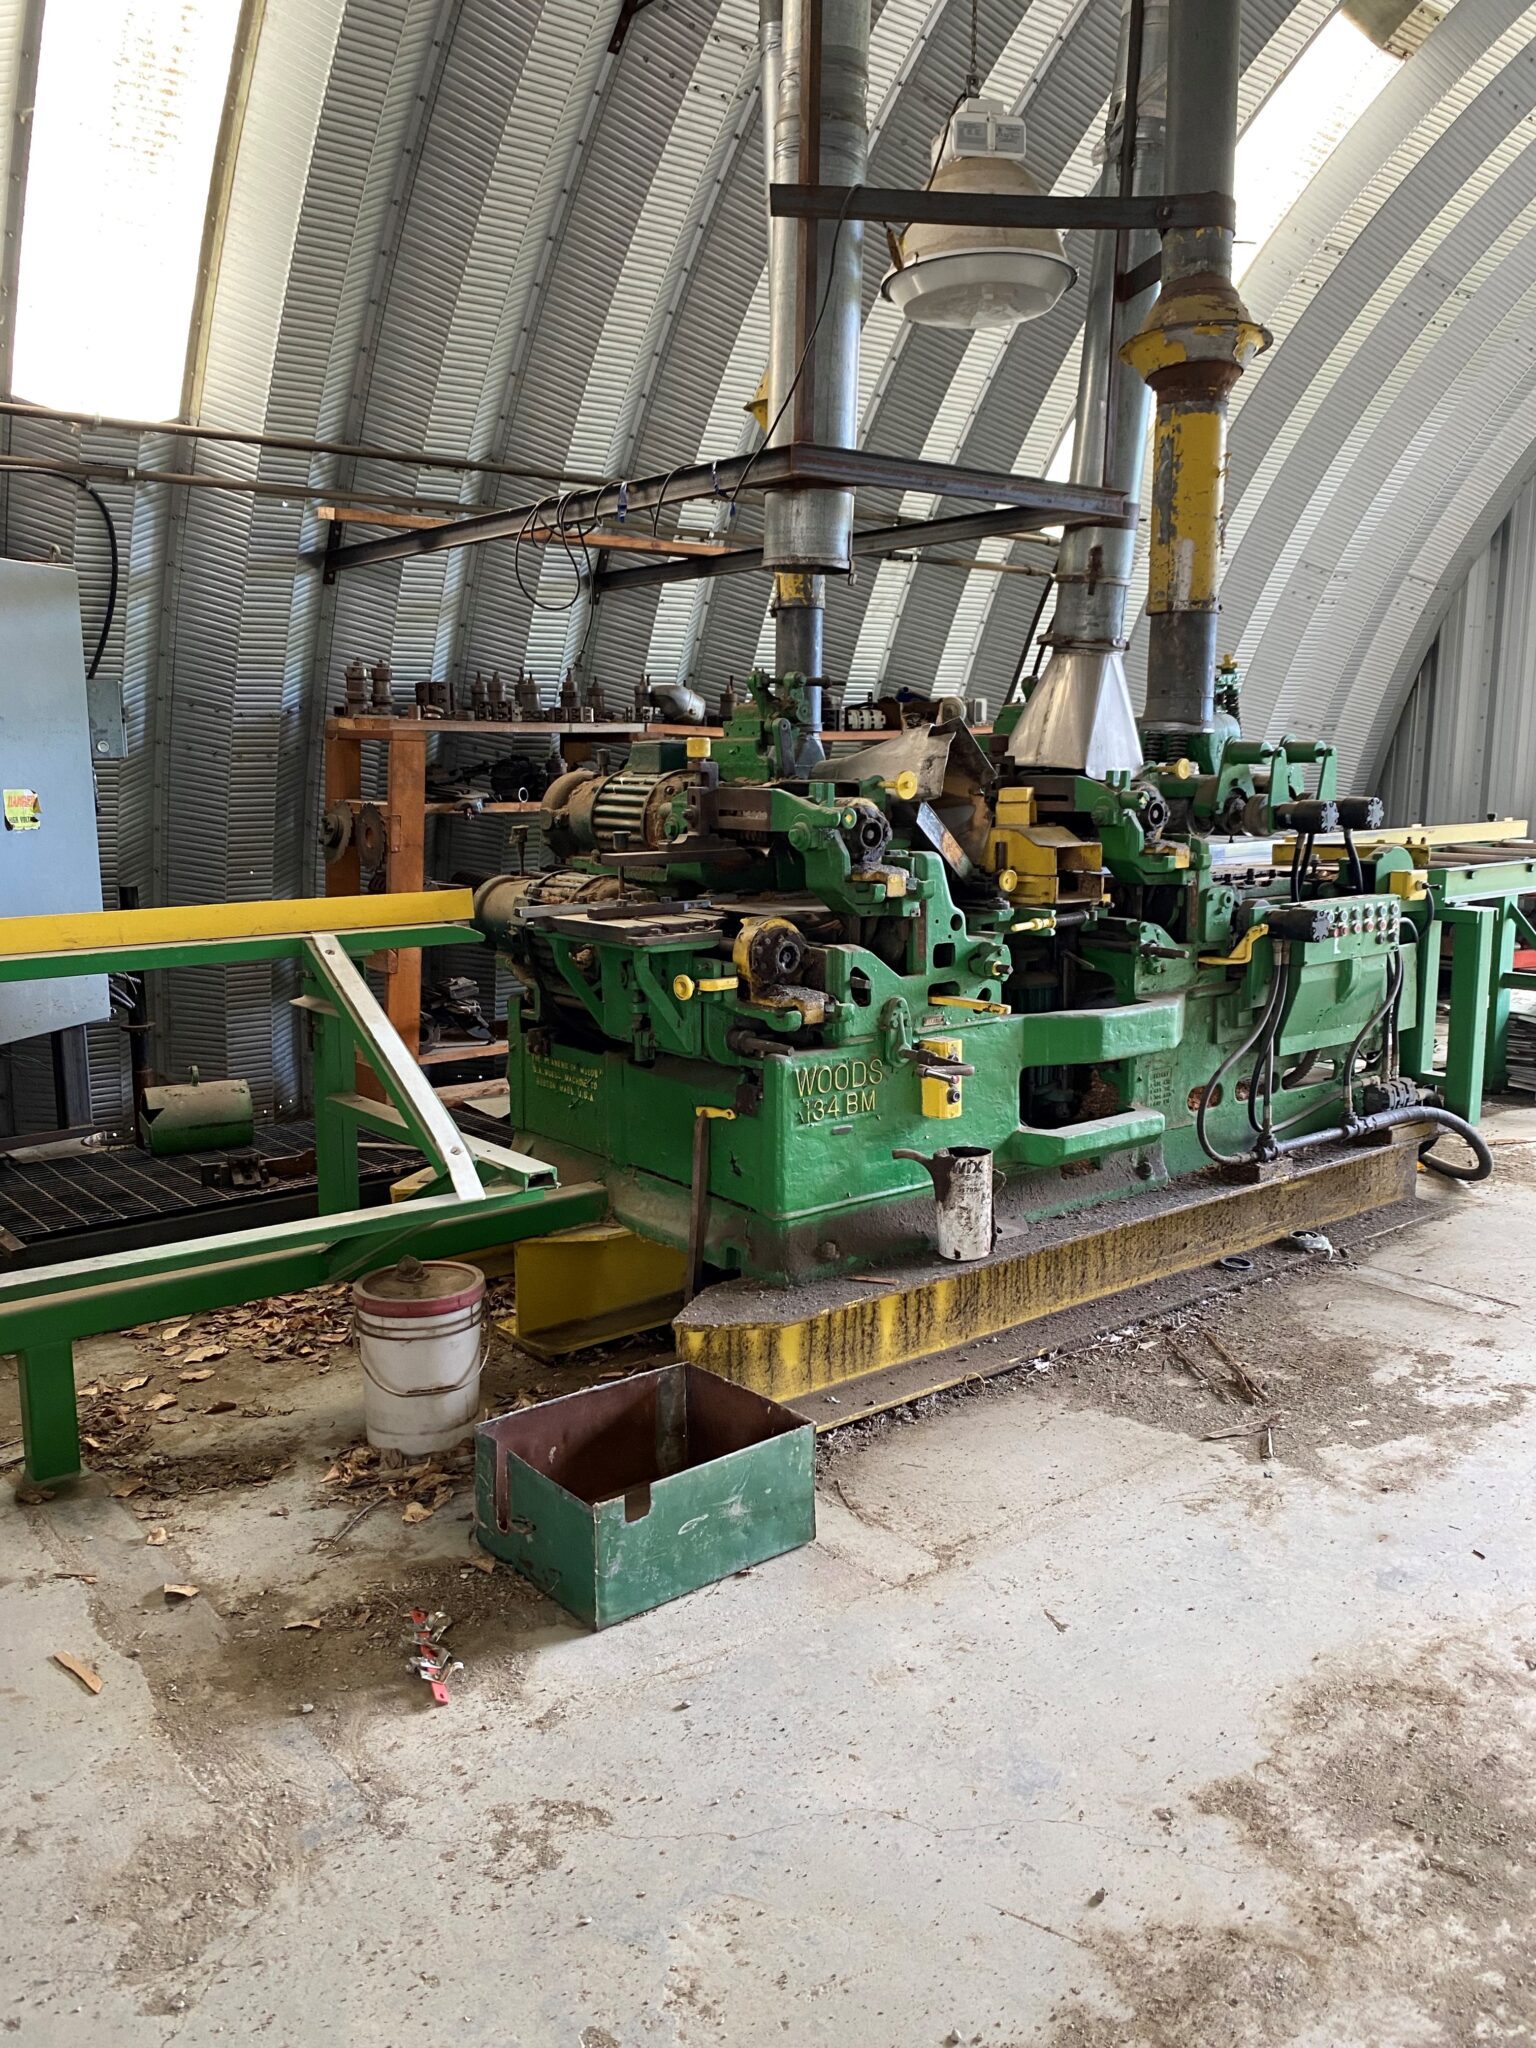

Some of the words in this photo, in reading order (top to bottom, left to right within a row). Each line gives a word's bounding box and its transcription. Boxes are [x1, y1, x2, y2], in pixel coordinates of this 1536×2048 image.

[795, 1059, 883, 1097] WOODS
[803, 1094, 840, 1123] 134
[846, 1089, 876, 1114] BM
[952, 1160, 983, 1174] WIX
